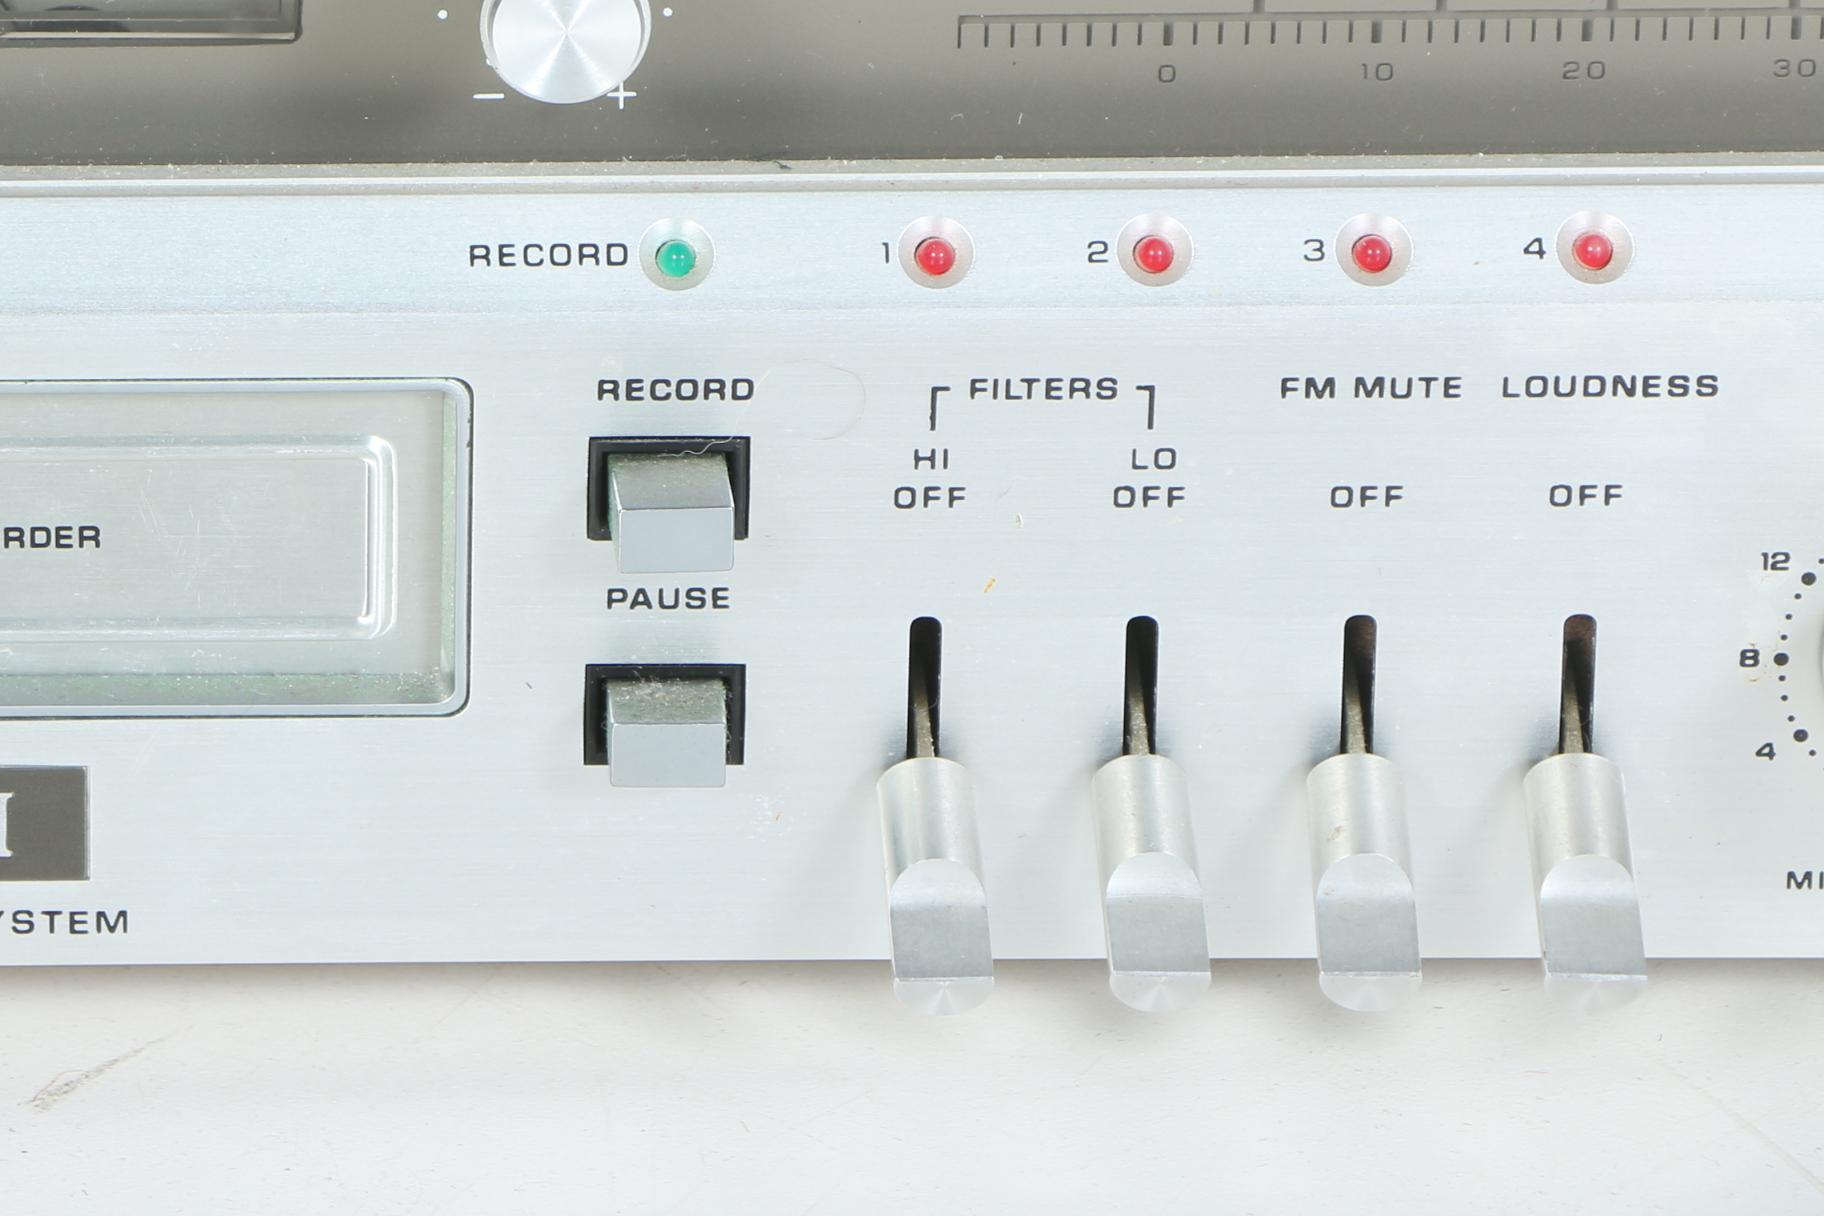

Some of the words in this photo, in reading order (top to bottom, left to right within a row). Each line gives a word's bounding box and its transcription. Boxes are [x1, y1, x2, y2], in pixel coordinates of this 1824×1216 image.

[1157, 64, 1177, 84] 0
[1361, 62, 1394, 82] 10
[1561, 60, 1606, 80] 20
[1773, 58, 1817, 78] 30
[469, 242, 628, 267] RECORD
[881, 242, 890, 264] 1
[1087, 240, 1109, 264] 2
[1303, 238, 1326, 262] 3
[1523, 237, 1547, 260] 4
[597, 378, 754, 402] RECORD
[969, 377, 1118, 401] FILTERS
[1280, 376, 1336, 400] FM
[1354, 376, 1462, 400] MUTE
[1502, 374, 1719, 399] LOUDNESS
[913, 448, 949, 470] HI
[1131, 447, 1177, 470] LO
[893, 486, 966, 510] OFF
[1113, 485, 1185, 509] OFF
[1330, 485, 1404, 508] OFF
[1549, 484, 1623, 508] OFF
[1761, 551, 1791, 571] 12
[606, 586, 730, 610] PAUSE
[1739, 648, 1760, 668] 8
[1755, 742, 1776, 761] 4
